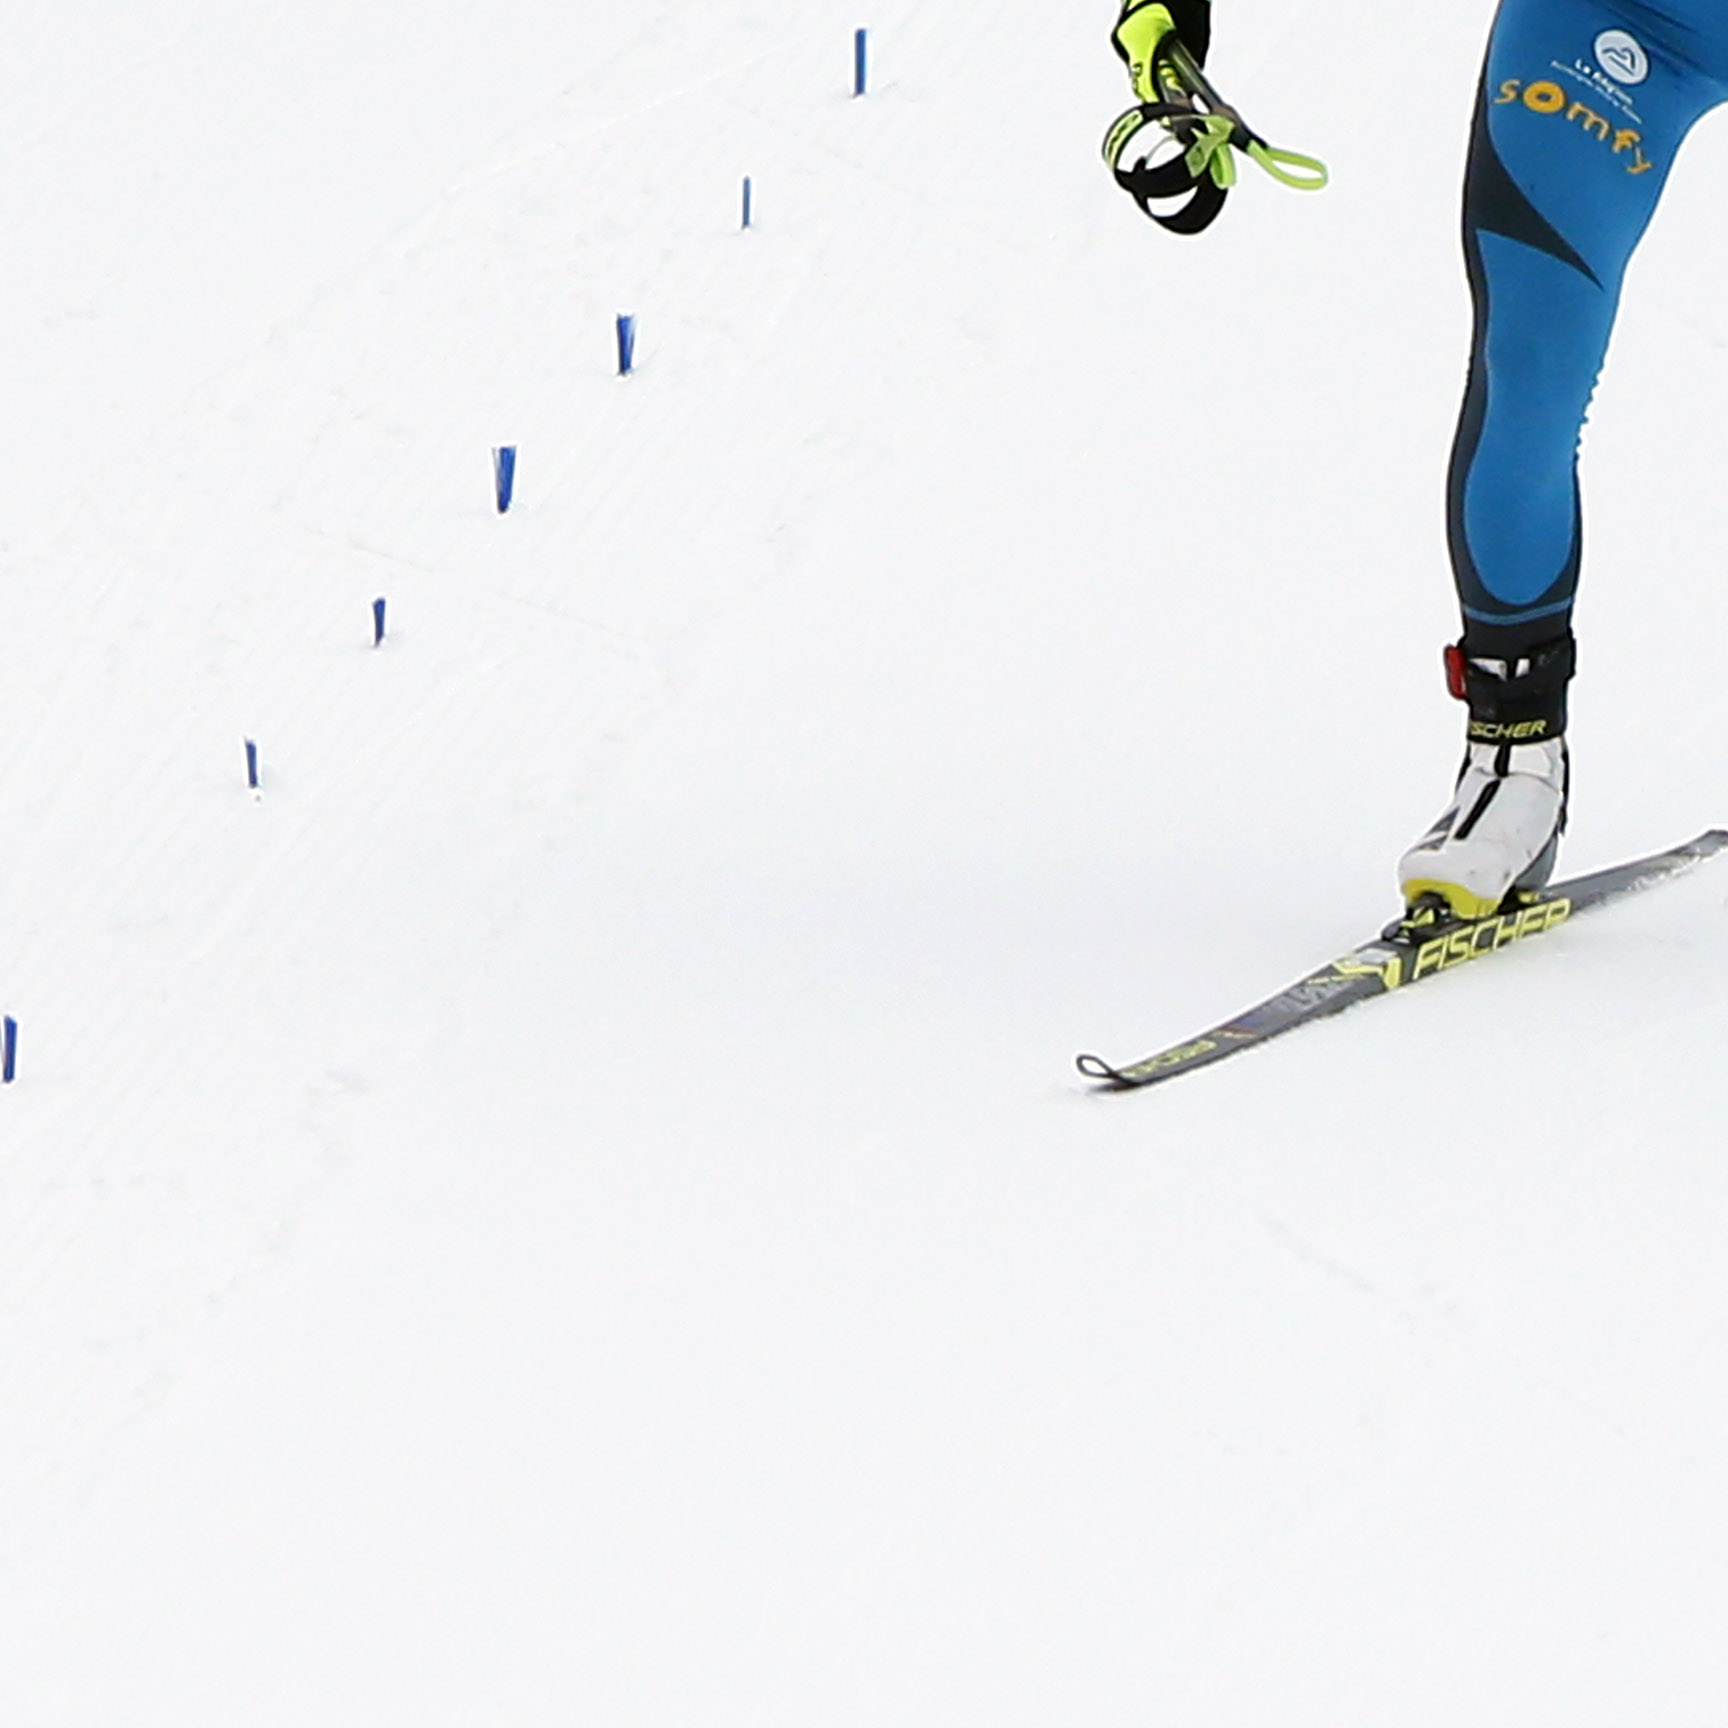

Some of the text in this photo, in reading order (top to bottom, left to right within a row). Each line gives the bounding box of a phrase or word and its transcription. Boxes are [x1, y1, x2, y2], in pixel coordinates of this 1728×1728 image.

[1493, 78, 1654, 175] somfy
[1470, 719, 1547, 739] SCHER
[1412, 897, 1571, 981] FISCHER
